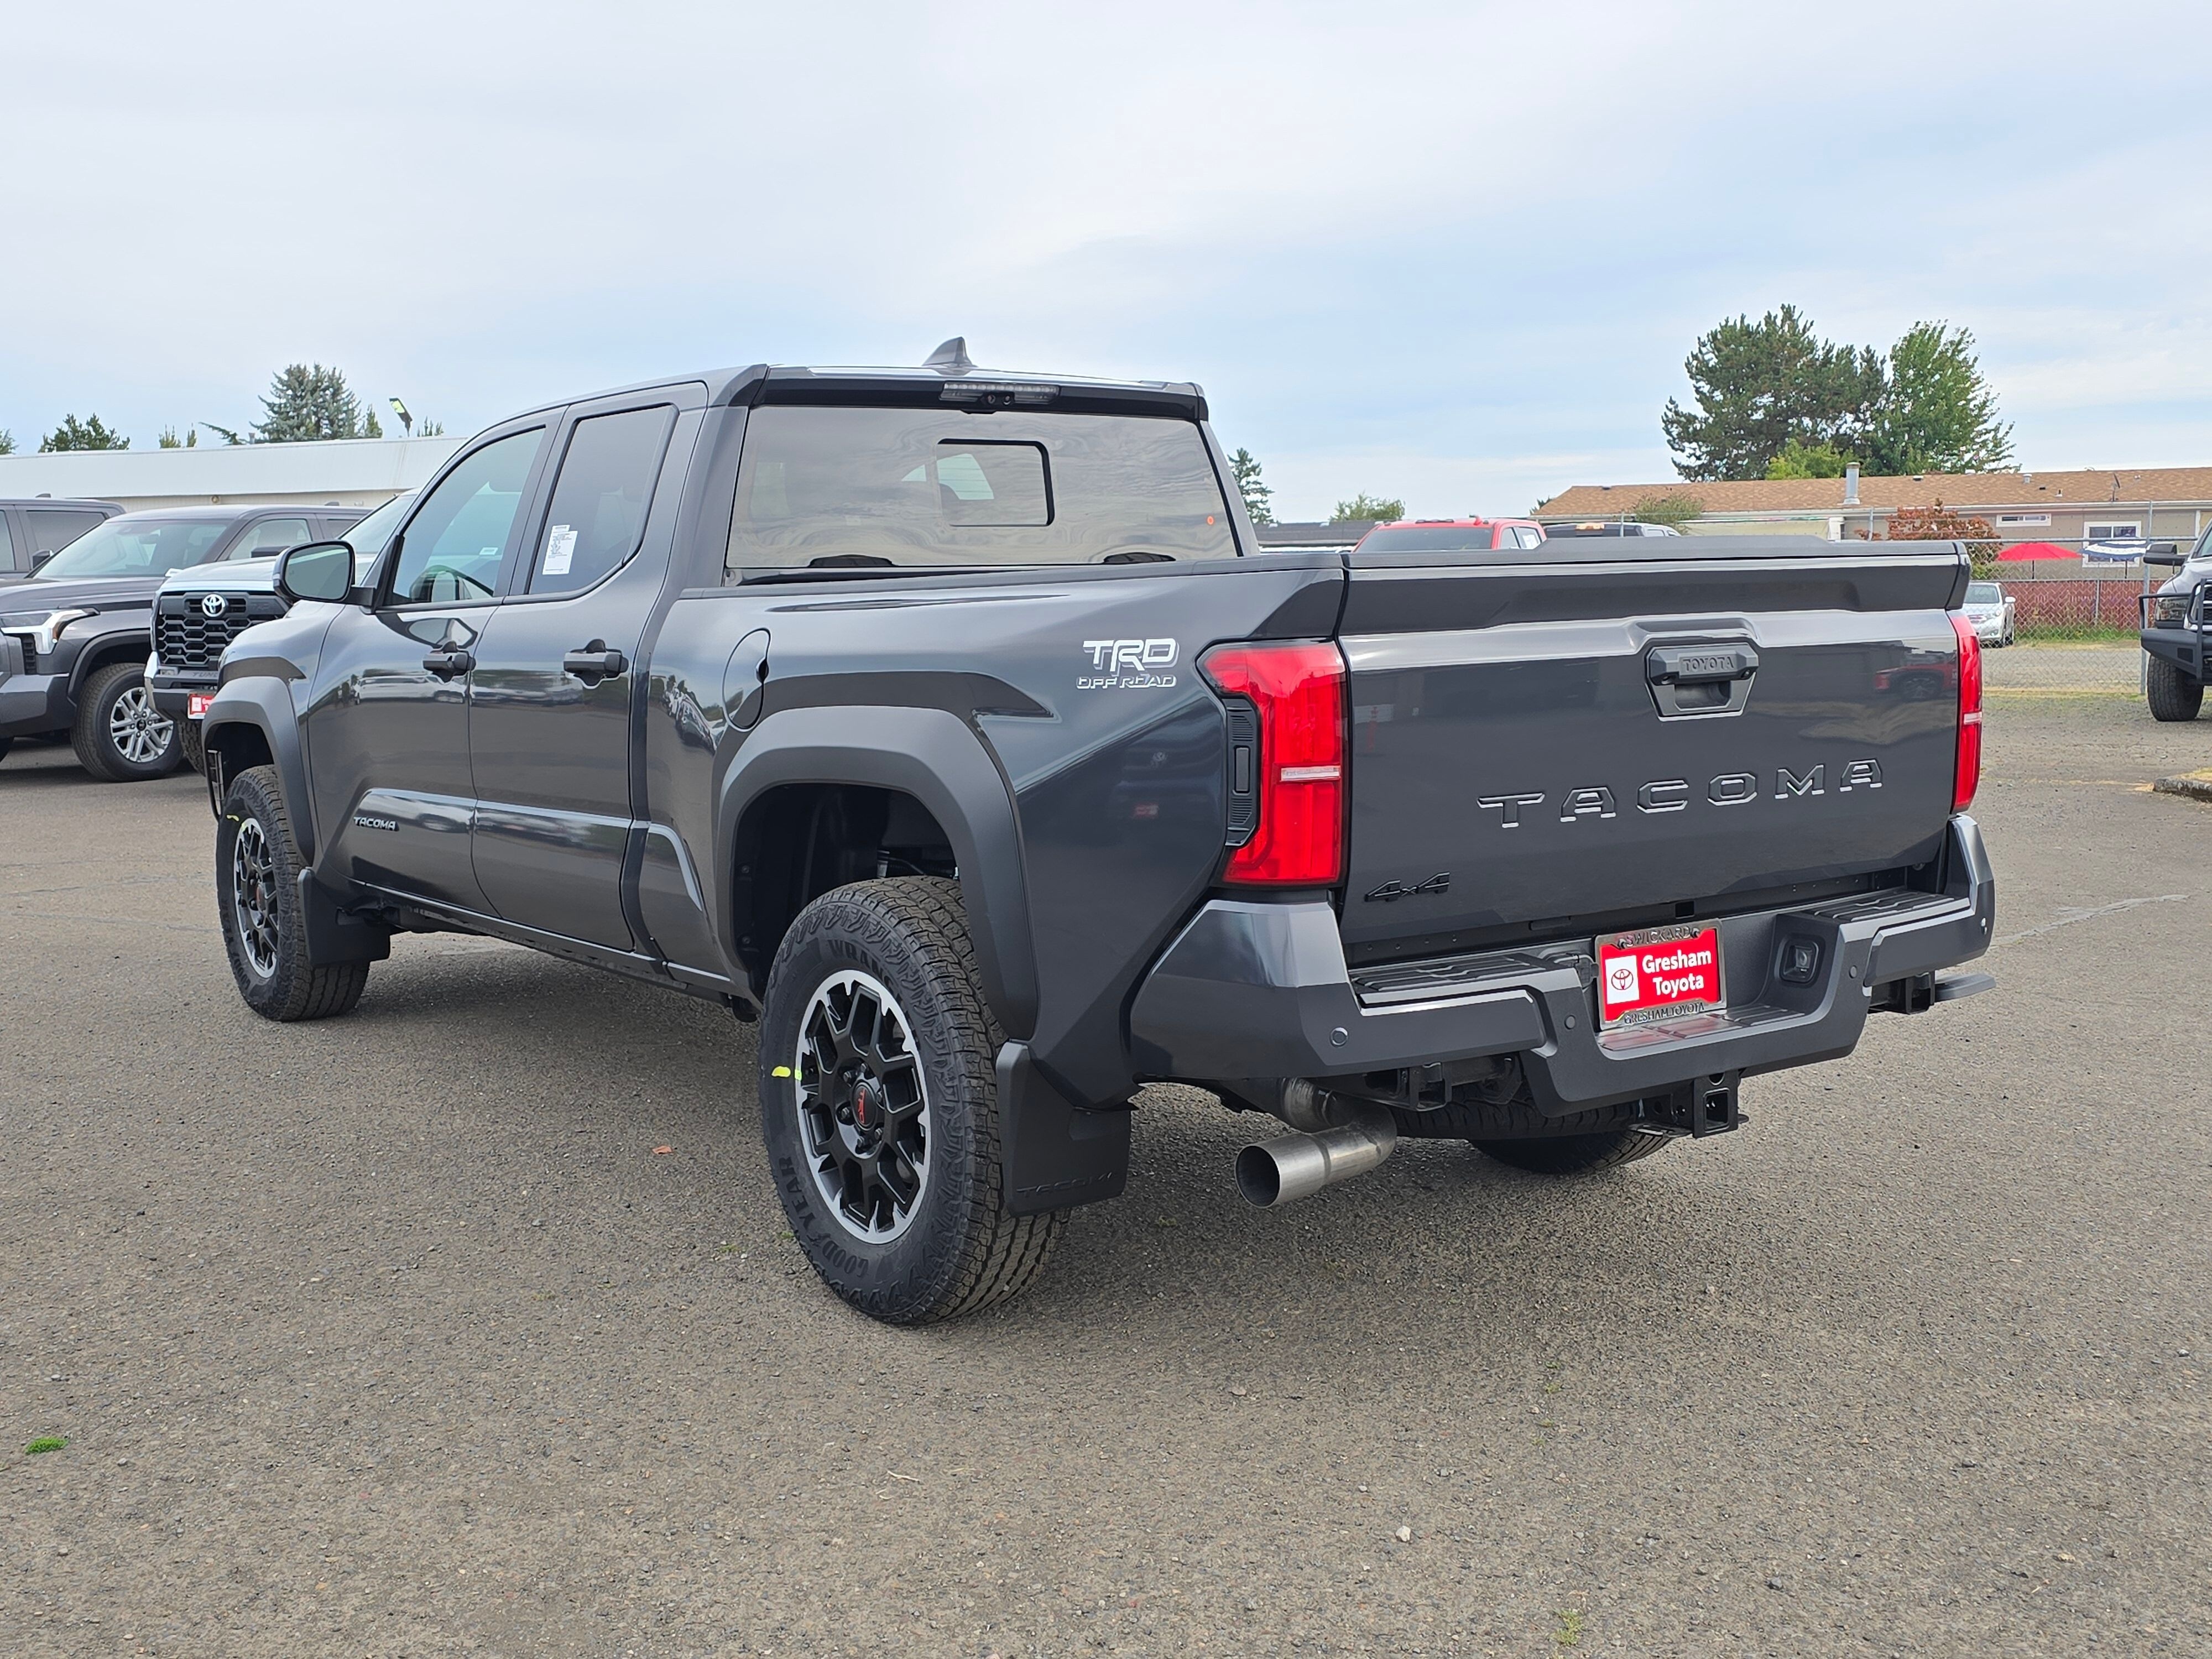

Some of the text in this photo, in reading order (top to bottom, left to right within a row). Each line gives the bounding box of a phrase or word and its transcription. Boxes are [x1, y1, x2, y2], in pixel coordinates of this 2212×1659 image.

[1082, 638, 1180, 677] TRD
[1683, 656, 1734, 671] TOYOTA
[1076, 674, 1177, 689] OFF ROAD
[1477, 758, 1882, 828] TACOMA
[354, 816, 399, 832] TACOMA
[1625, 927, 1691, 947] SWICKARD
[1642, 950, 1712, 974] Gresham
[1652, 973, 1704, 998] Toyota
[1624, 1001, 1704, 1024] GRESHAM TOYOTA
[779, 1156, 869, 1277] GOODYEAR
